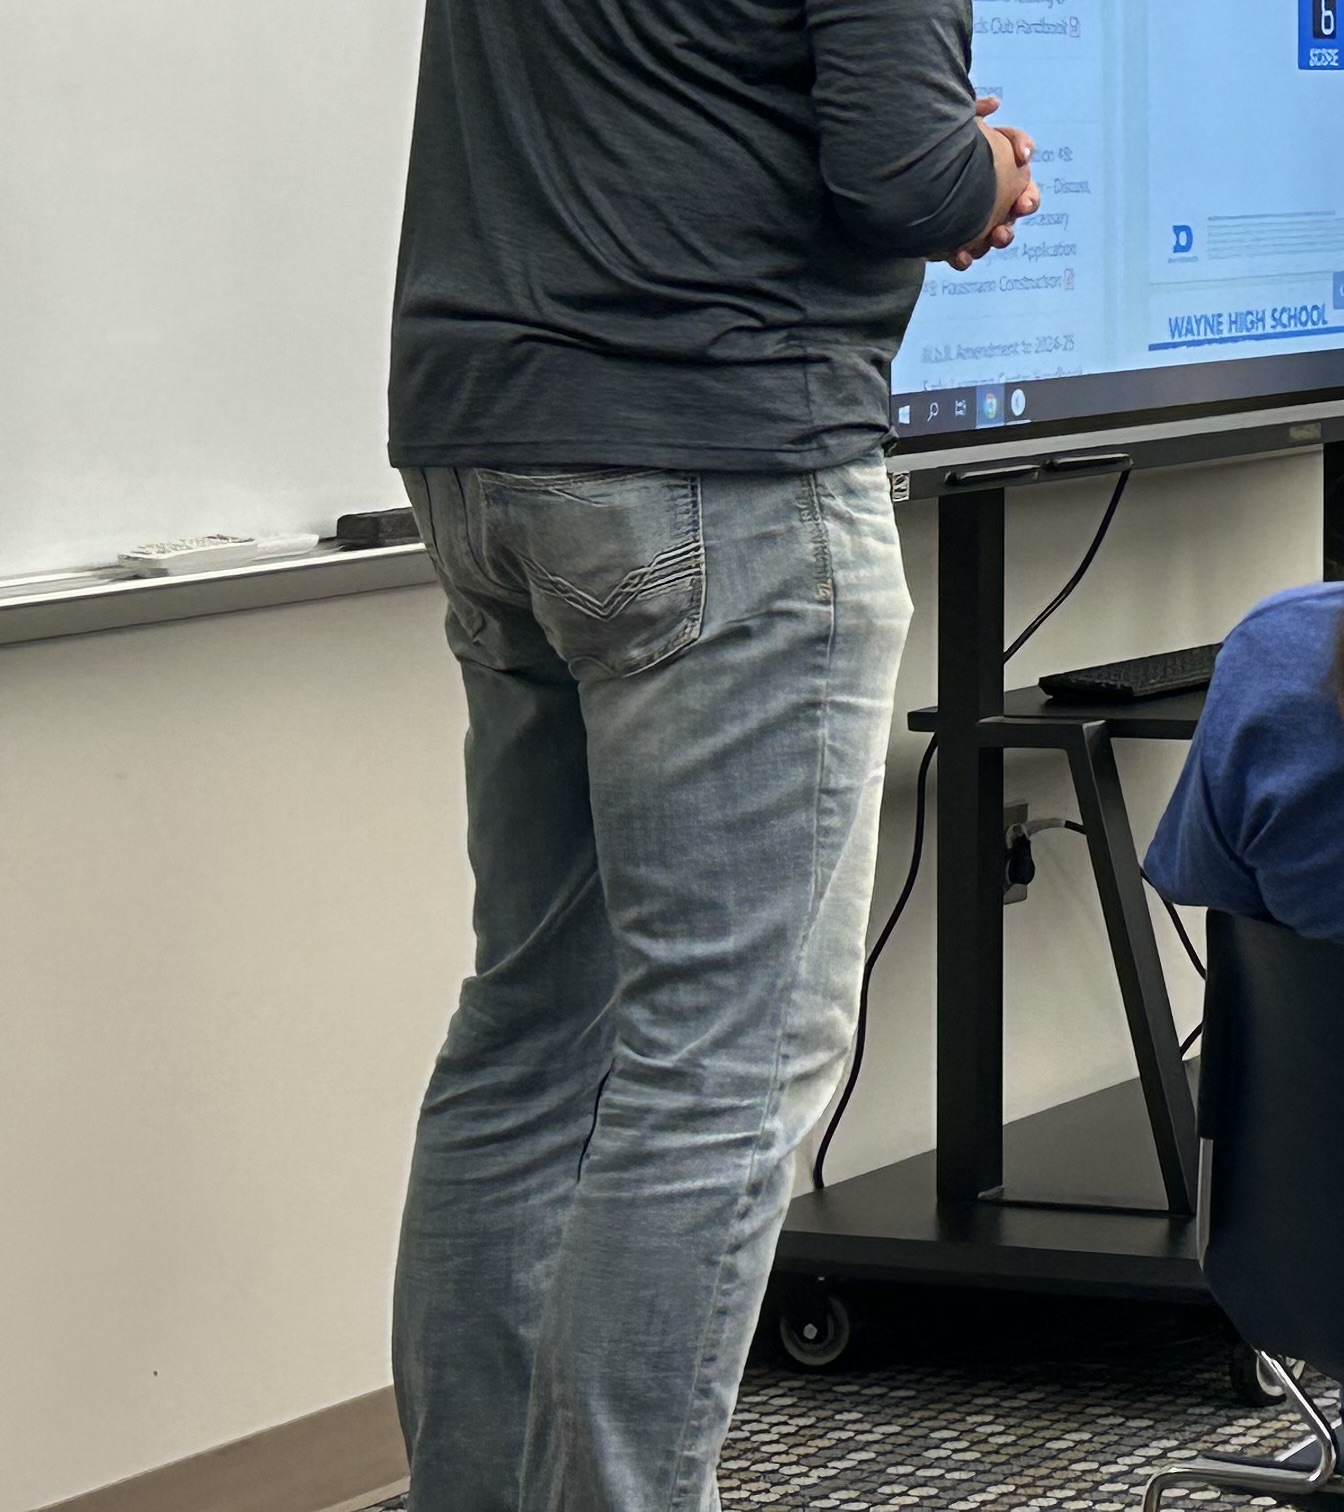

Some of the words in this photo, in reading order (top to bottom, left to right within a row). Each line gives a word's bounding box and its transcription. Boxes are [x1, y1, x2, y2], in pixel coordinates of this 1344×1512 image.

[1168, 313, 1223, 339] WAYNE
[1228, 308, 1266, 334] HIGH
[1270, 303, 1328, 329] SCHOOL
